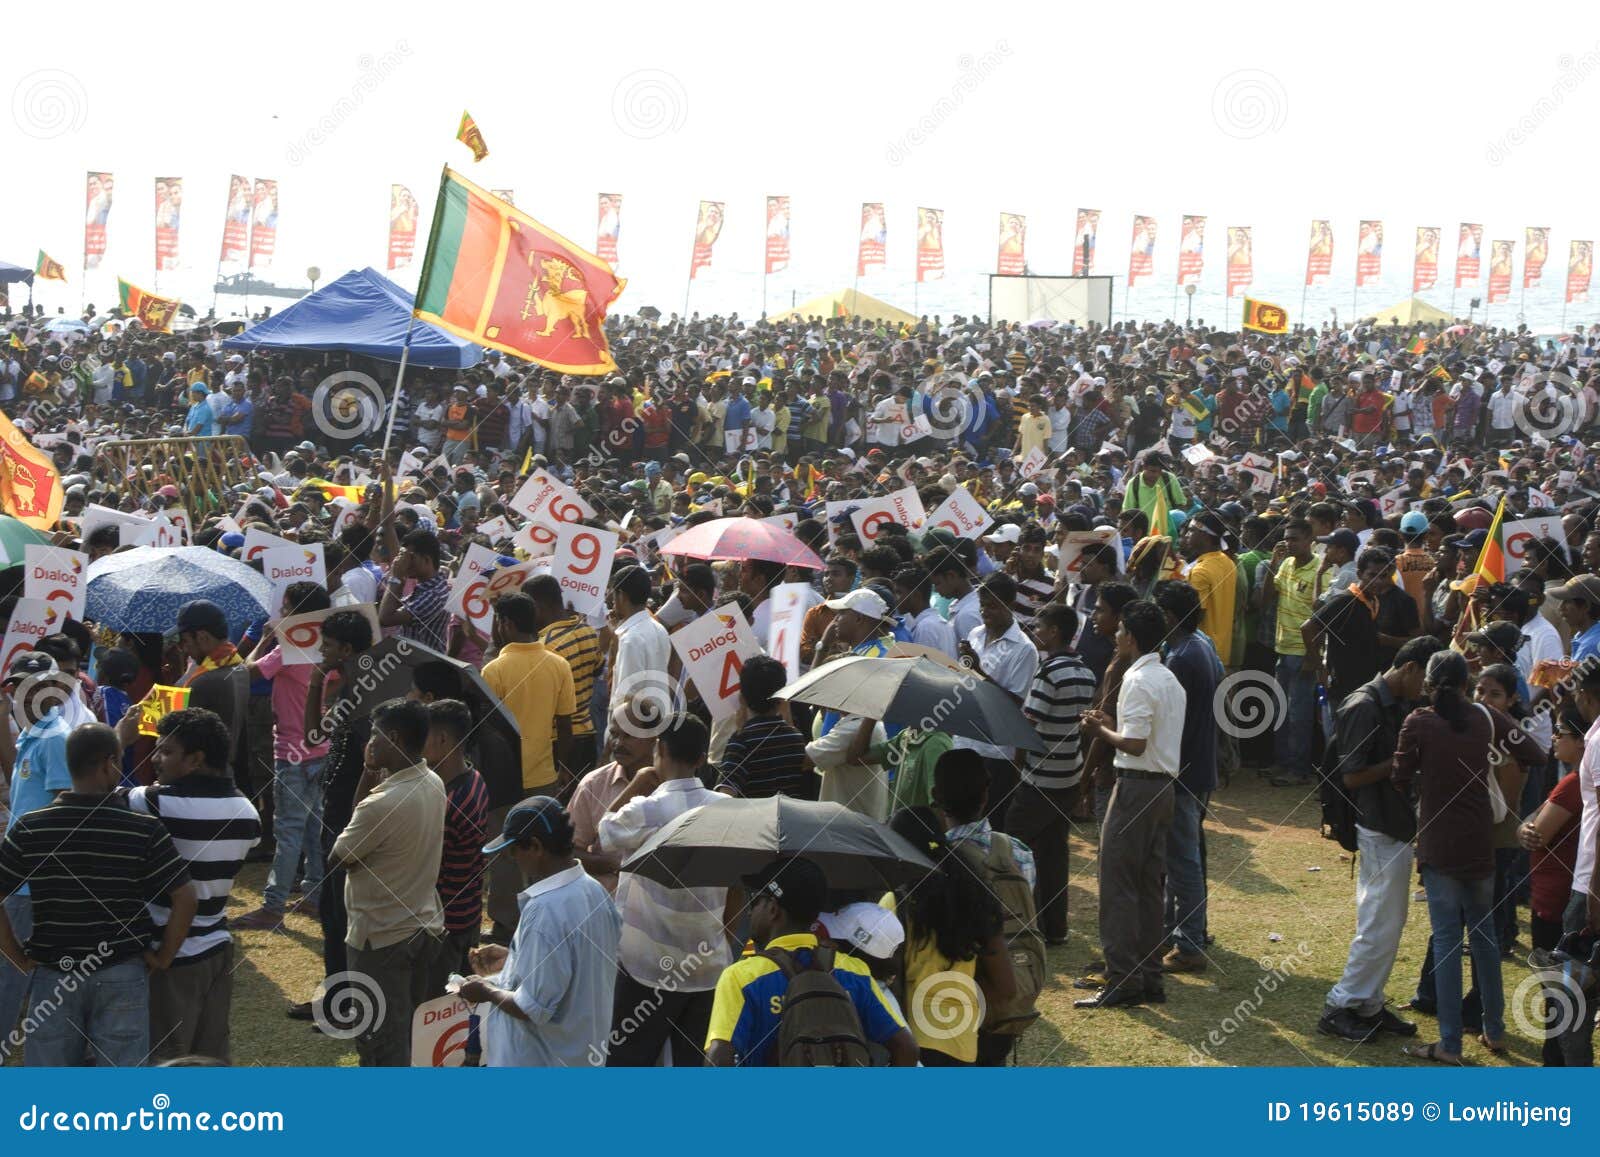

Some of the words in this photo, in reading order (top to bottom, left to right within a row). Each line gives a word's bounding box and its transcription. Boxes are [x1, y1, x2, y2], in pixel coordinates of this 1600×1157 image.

[527, 484, 555, 513] Dialog
[949, 500, 974, 532] Dialog
[33, 566, 77, 587] Dialog
[271, 565, 313, 579] Dialog
[463, 581, 490, 618] 6
[560, 576, 600, 597] Dialog
[688, 629, 738, 662] Dialog
[423, 1001, 469, 1026] Dialo
